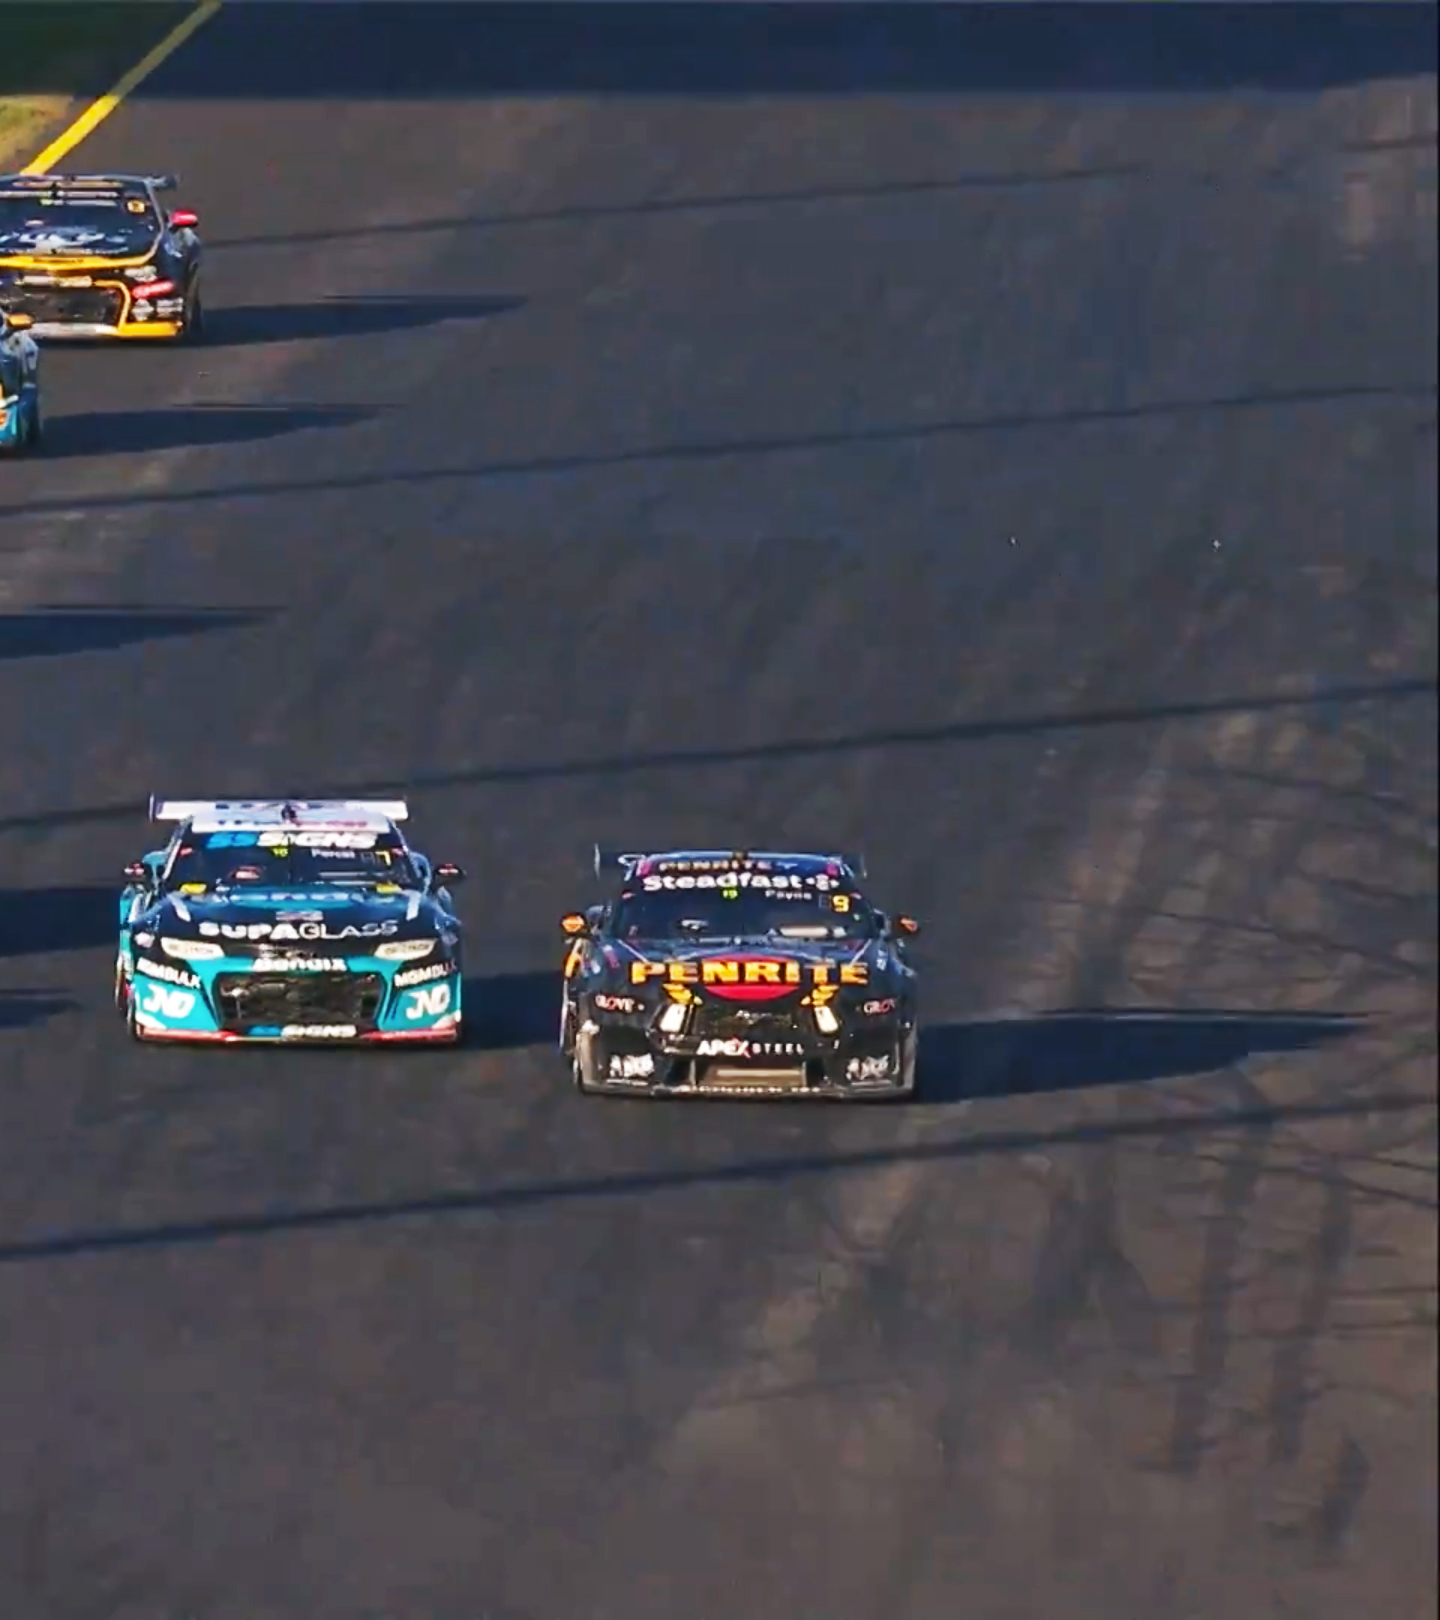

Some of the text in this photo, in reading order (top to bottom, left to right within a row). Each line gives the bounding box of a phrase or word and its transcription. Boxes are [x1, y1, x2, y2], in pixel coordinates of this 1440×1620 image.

[642, 872, 803, 891] Steadfast
[832, 894, 850, 912] 9
[198, 920, 399, 940] SUPAGLASS
[630, 961, 869, 984] PENRITE
[696, 1037, 805, 1058] APEX STEEL
